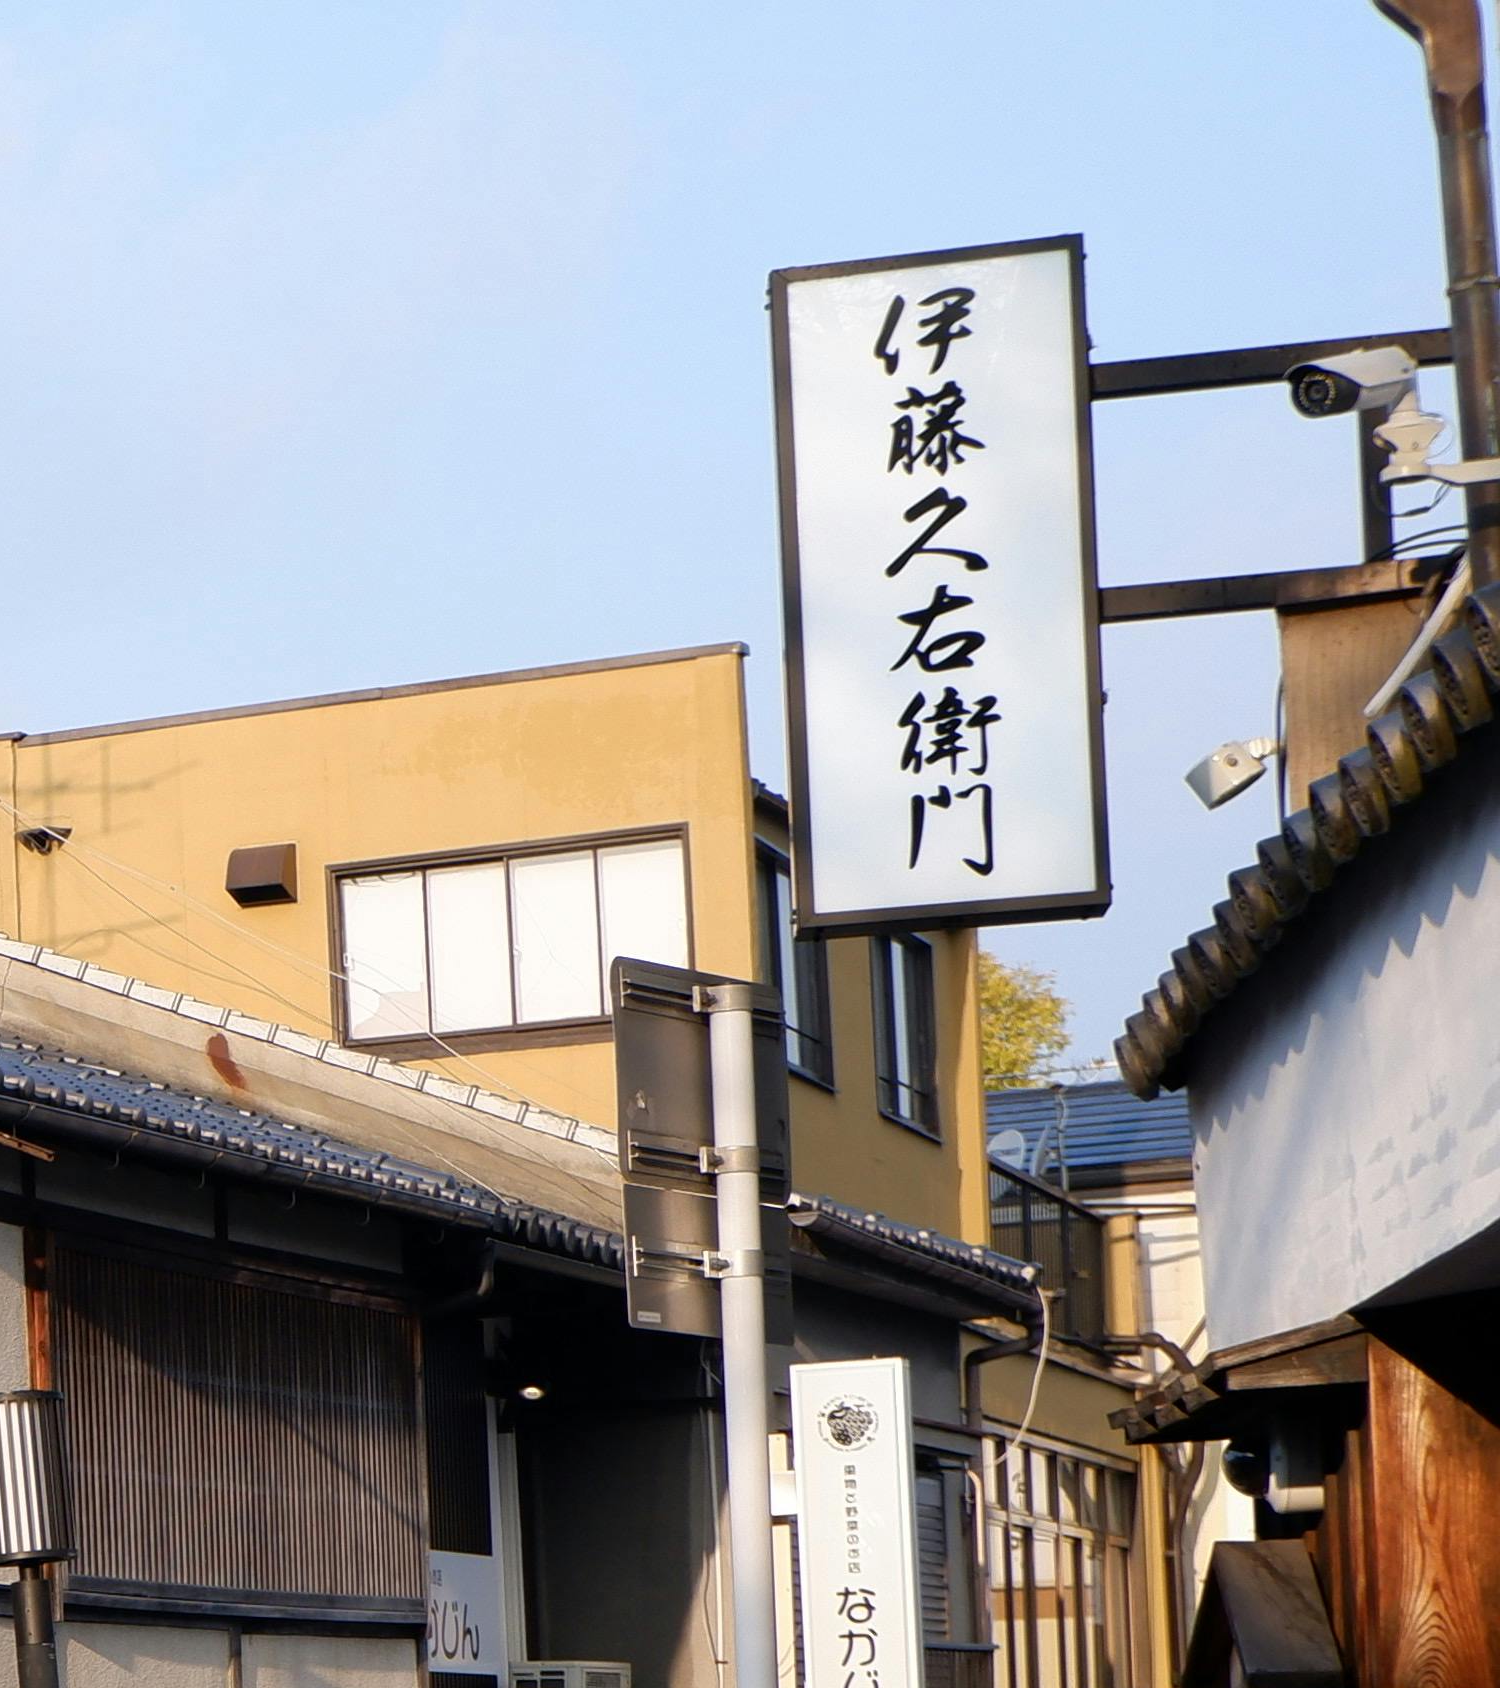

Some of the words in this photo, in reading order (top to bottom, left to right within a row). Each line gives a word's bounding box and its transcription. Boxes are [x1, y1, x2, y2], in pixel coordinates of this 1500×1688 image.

[872, 286, 1002, 877] 伊藤久右衛門
